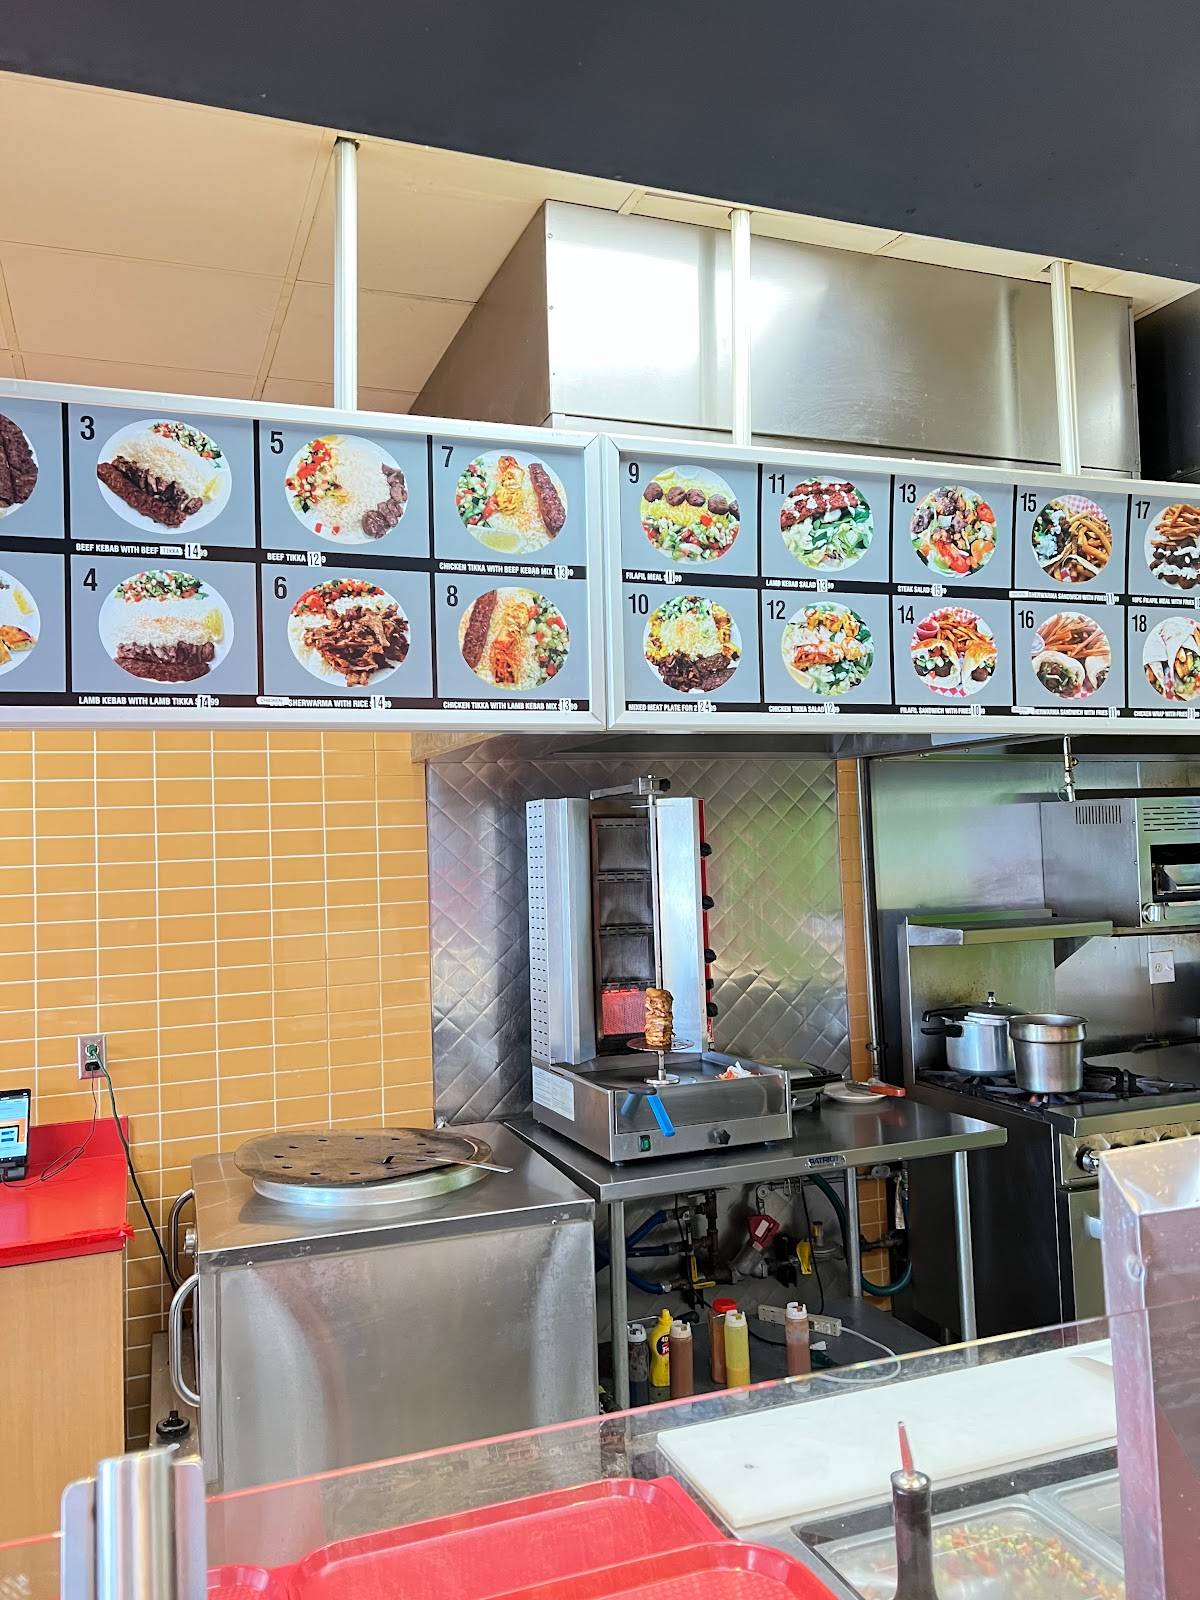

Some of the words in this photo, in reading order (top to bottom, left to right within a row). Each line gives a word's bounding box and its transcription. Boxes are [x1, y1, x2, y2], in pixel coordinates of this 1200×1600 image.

[80, 415, 95, 441] 3
[270, 430, 284, 455] 5
[441, 445, 454, 468] 7
[628, 462, 640, 484] 9
[768, 473, 785, 495] 11
[898, 482, 917, 504] 13
[1020, 492, 1037, 513] 15
[1134, 500, 1151, 520] 17
[75, 543, 94, 551] BEEF
[95, 543, 119, 553] KEBAB
[120, 545, 139, 554] WITH
[141, 546, 159, 555] BEEF
[266, 552, 285, 561] BEEF
[286, 553, 306, 562] TIKKA
[439, 562, 467, 571] CHICKEN
[467, 563, 486, 573] TIKKA
[486, 564, 503, 574] WITH
[504, 565, 519, 574] BEEF
[520, 566, 539, 575] KEBAB
[540, 567, 553, 576] MIX
[647, 573, 663, 581] MEAL
[83, 567, 98, 592] 4
[274, 576, 288, 600] 6
[765, 579, 781, 587] LAMB
[782, 580, 798, 588] KEBAB
[446, 585, 459, 607] 8
[897, 585, 914, 593] STEAK
[914, 586, 930, 594] SALAD
[628, 593, 649, 615] 10
[766, 599, 786, 620] 12
[897, 604, 915, 625] 14
[1017, 610, 1034, 629] 16
[1131, 614, 1147, 633] 18
[79, 696, 101, 705] LAMB
[102, 696, 126, 705] KEBAB
[128, 697, 148, 705] WITH
[149, 697, 171, 705] LAMB
[172, 697, 194, 706] TIKKA
[288, 699, 333, 708] SHERWARMA
[333, 700, 352, 708] WITH
[352, 700, 369, 708] RICE
[443, 701, 470, 709] CHICKEN
[471, 701, 489, 709] TIKKA
[507, 702, 524, 710] LAMB
[525, 702, 545, 710] KEBAB
[546, 702, 557, 710] MIX
[628, 703, 647, 711] MIXED
[664, 704, 681, 712] PLATE
[681, 704, 693, 712] FOR
[693, 704, 698, 712] 2
[768, 705, 792, 713] CHICKEN
[945, 707, 958, 715] WITH
